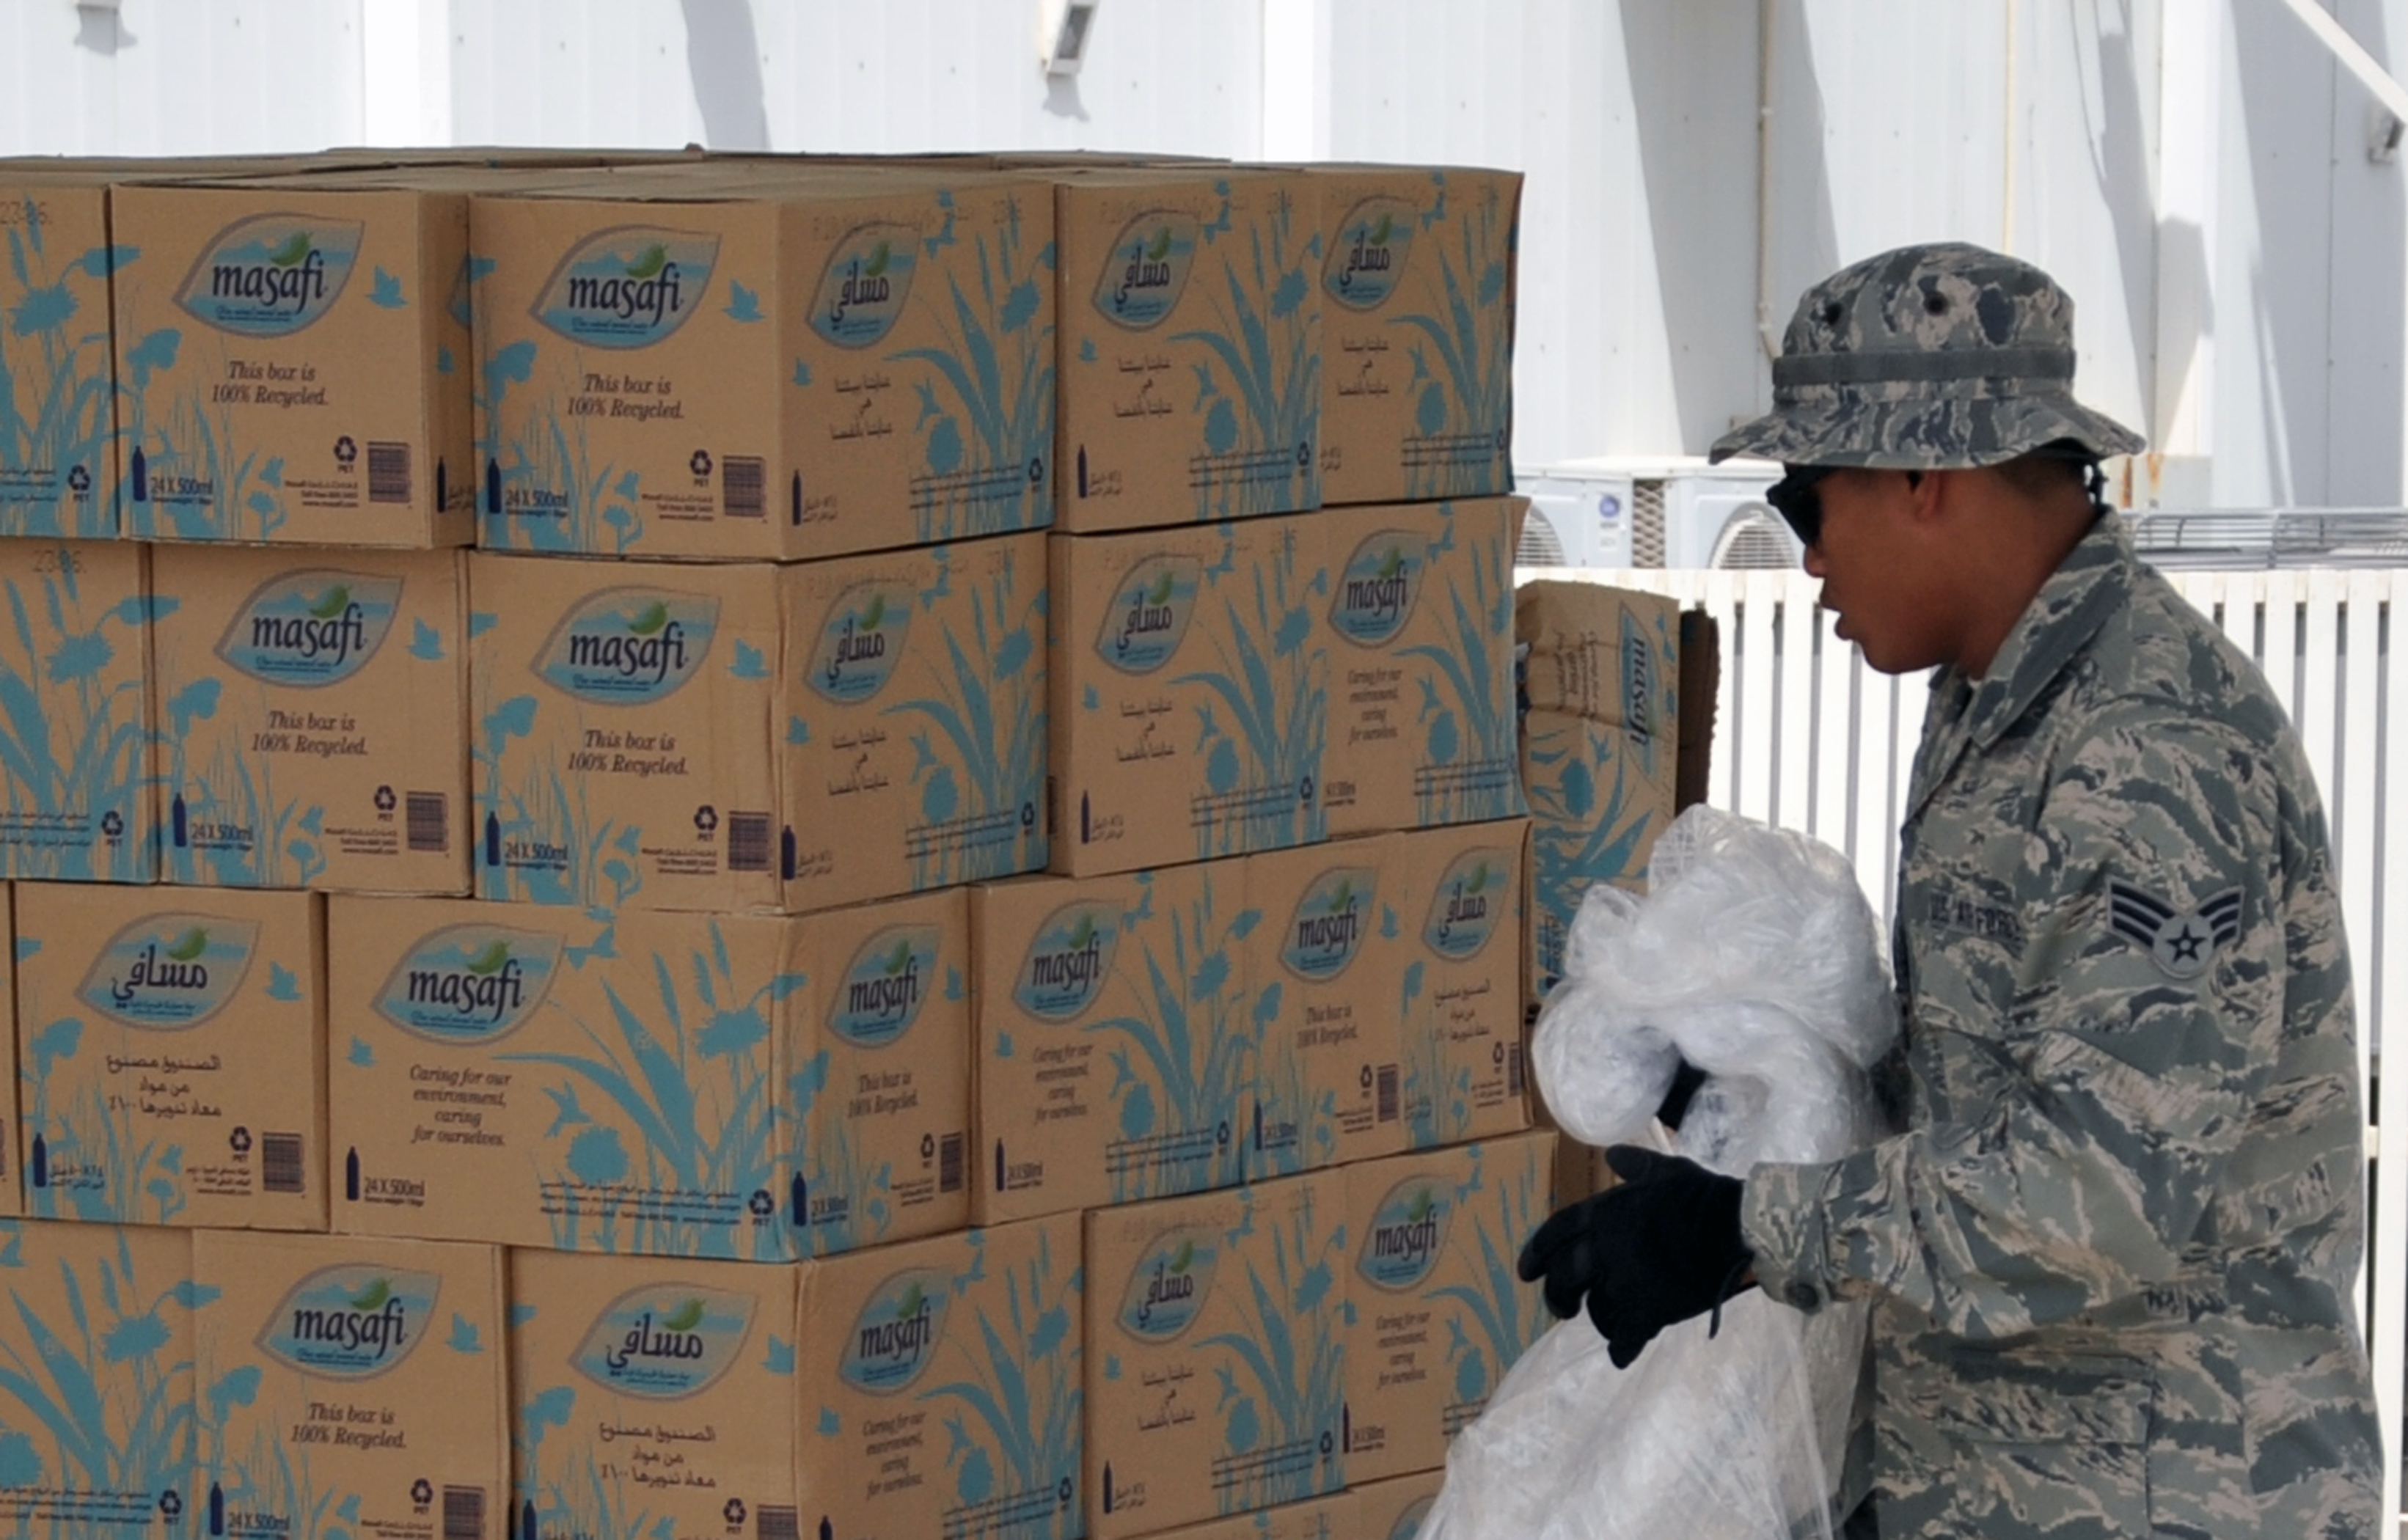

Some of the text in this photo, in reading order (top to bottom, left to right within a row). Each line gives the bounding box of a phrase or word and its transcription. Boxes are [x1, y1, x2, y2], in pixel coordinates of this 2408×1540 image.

[212, 249, 325, 315] masafi
[568, 261, 685, 327] masafi
[830, 259, 890, 331] مسافي
[1113, 245, 1170, 313] مسافي
[212, 384, 328, 408] 100% Recycled.
[229, 360, 316, 381] This box is
[584, 373, 672, 395] This box is
[567, 397, 684, 422] 100% Recycled.
[1346, 559, 1408, 622] masafi
[252, 602, 366, 667] masafi
[568, 620, 687, 685] masafi
[827, 616, 885, 689] مسافي
[1116, 591, 1172, 659] مسافي
[268, 710, 356, 732] This box is
[1629, 637, 1650, 747] masafi
[252, 733, 368, 759] 100% Recycled.
[568, 751, 689, 779] 100% Recycled.
[585, 729, 676, 752] This box is
[1298, 895, 1357, 956] masafi
[111, 939, 208, 1009] مسافي
[409, 958, 524, 1023] masafi
[849, 956, 918, 1022] masafi
[1033, 931, 1099, 995] masafi
[409, 1064, 513, 1088] Caring for our
[410, 1124, 435, 1145] for
[433, 1110, 483, 1129] caring
[1375, 1203, 1438, 1264] masafi
[1138, 1261, 1193, 1329] مسافي
[293, 1297, 405, 1360] masafi
[606, 1312, 704, 1377] مسافي
[859, 1296, 932, 1363] masafi
[290, 1424, 408, 1451] 100% Recycled.
[310, 1401, 397, 1426] This box is
